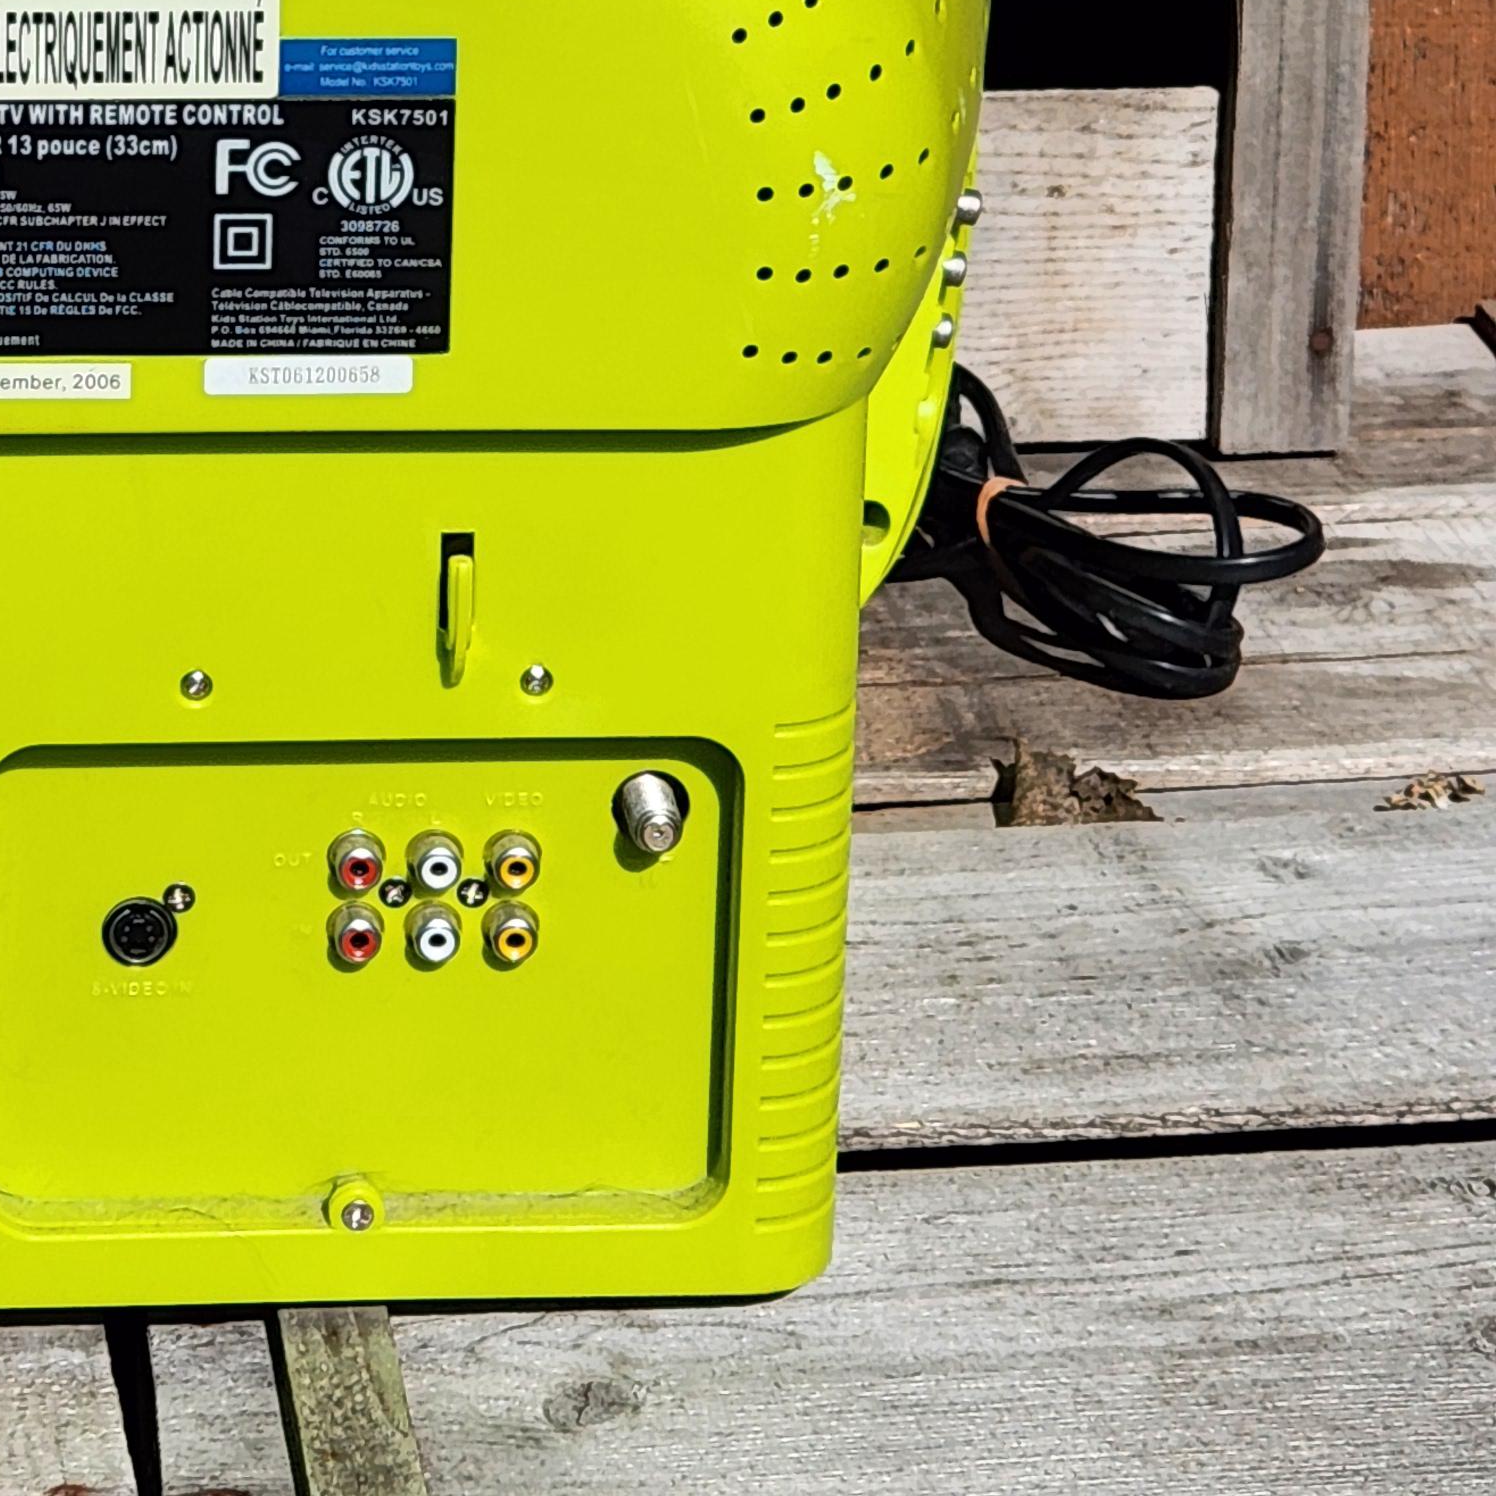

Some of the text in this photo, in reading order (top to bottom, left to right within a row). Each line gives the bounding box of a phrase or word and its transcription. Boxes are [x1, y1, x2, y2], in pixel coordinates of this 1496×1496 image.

[28, 104, 84, 125] WITH
[89, 104, 178, 125] REMOTE
[182, 104, 285, 125] CONTROL
[351, 108, 448, 126] KSK7501
[7, 134, 32, 155] 13
[37, 138, 101, 160] pouce
[106, 134, 178, 161] (33cm)
[412, 188, 444, 206] US
[340, 220, 400, 232] 3098726
[6, 267, 74, 278] COMPUTING
[76, 267, 119, 278] DEVICE
[72, 373, 121, 390] 2006
[248, 366, 381, 384] KST061200658
